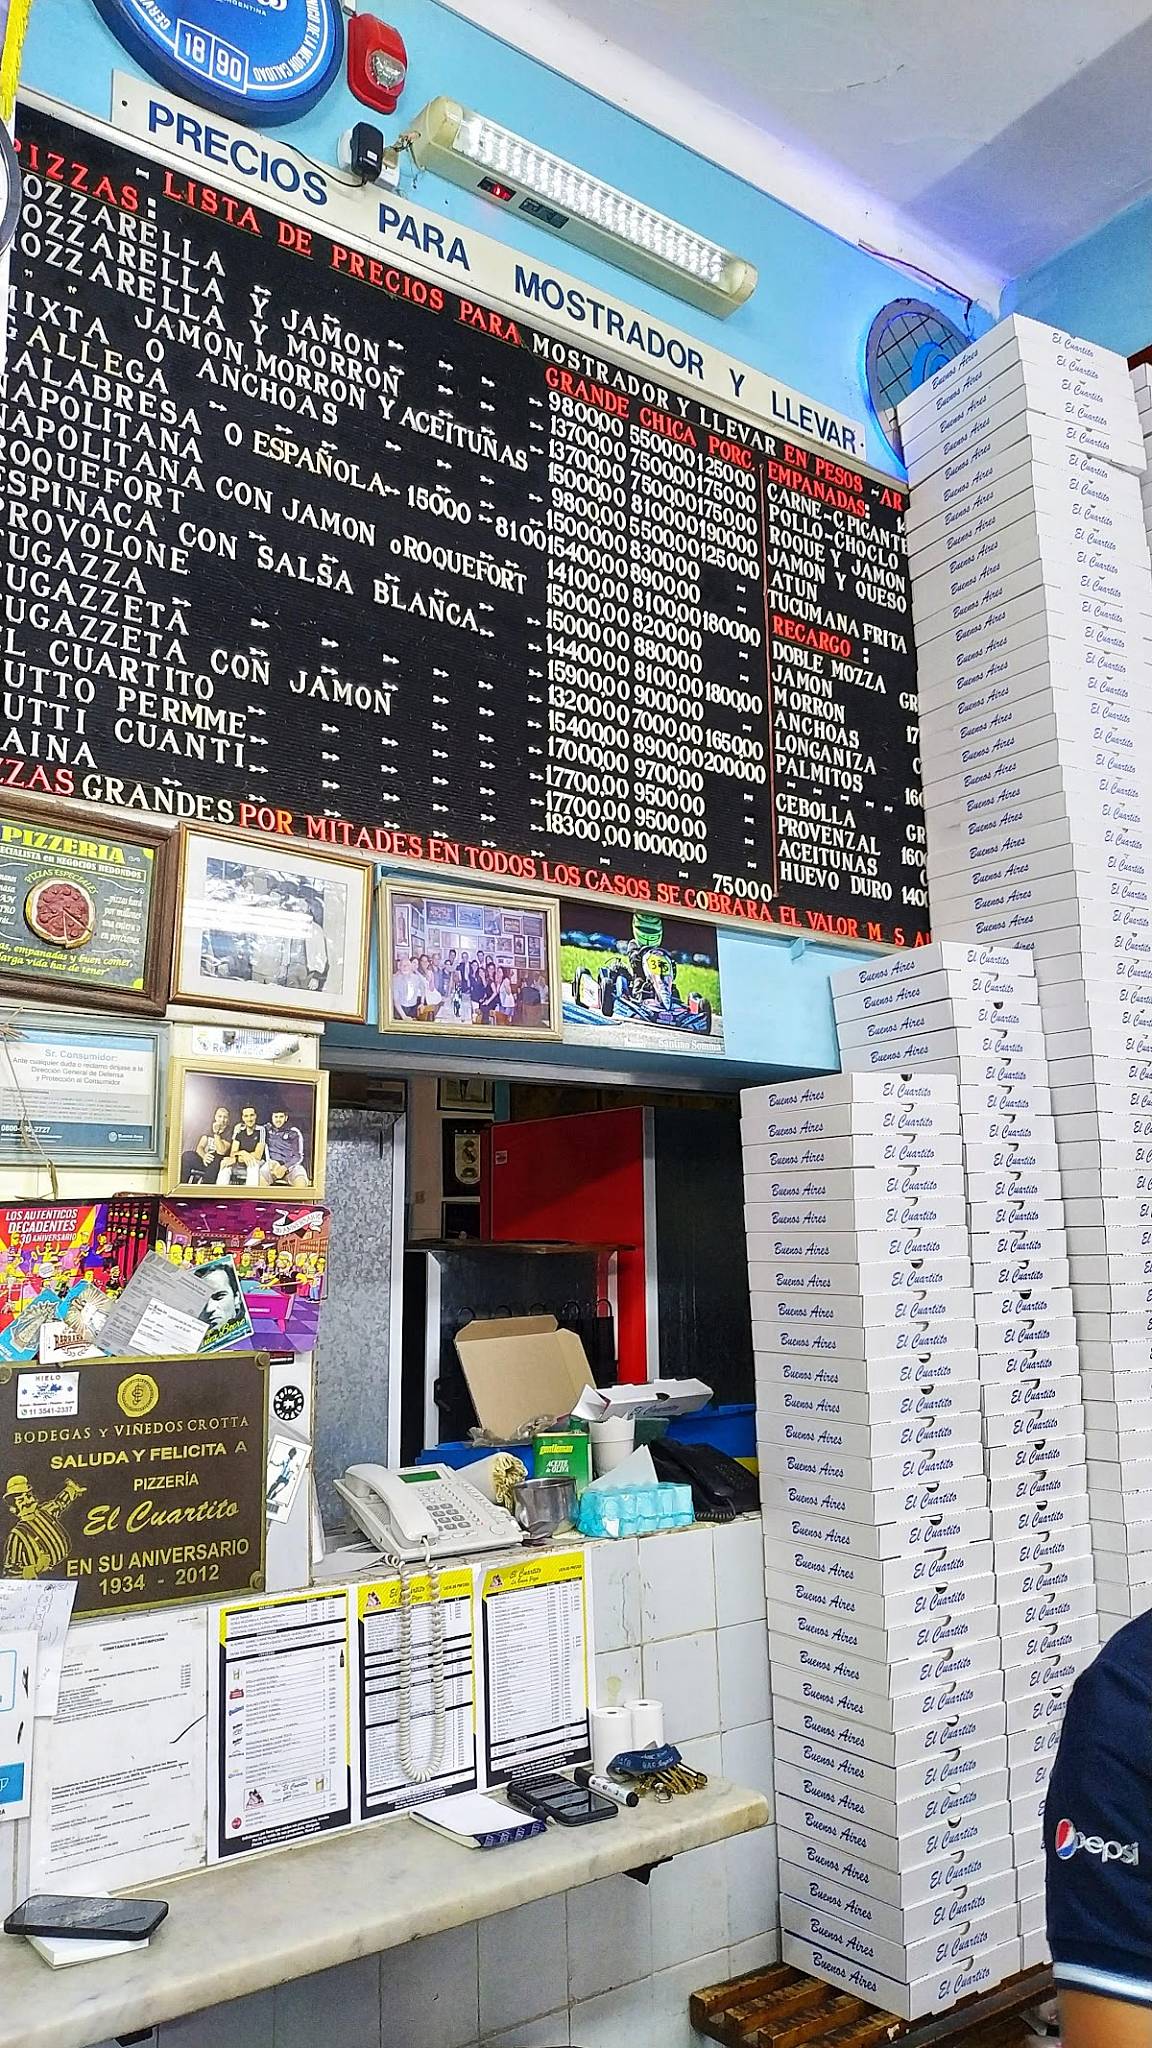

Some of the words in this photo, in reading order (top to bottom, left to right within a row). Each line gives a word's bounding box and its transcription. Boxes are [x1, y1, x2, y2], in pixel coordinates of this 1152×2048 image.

[184, 31, 206, 63] 18
[216, 47, 242, 83] 90
[252, 62, 294, 82] CALIDAD
[22, 173, 226, 277] OZZARELLA
[148, 101, 328, 207] PRECIOS
[378, 203, 470, 271] PARA
[515, 264, 704, 380] MOSTRADOR
[729, 368, 746, 397] Y
[22, 203, 225, 304] OZZARELLA
[249, 293, 269, 319] Y
[281, 309, 380, 365] JAMON
[163, 171, 262, 234] LISTA
[278, 221, 312, 256] DE
[331, 245, 445, 312] PRECIOS
[458, 300, 521, 347] PARA
[533, 333, 669, 411] MOSTRADOR
[677, 396, 690, 418] Y
[700, 407, 777, 456] LLEVAR
[783, 443, 808, 470] EN
[815, 457, 863, 492] PESOS
[1062, 336, 1095, 358] Cuartito
[249, 319, 268, 345] Y
[287, 334, 400, 397] MORRON
[931, 366, 957, 391] Buenos
[956, 348, 979, 370] Aires
[145, 338, 165, 363] O
[196, 358, 339, 426] ANCHOAS
[255, 350, 366, 411] MORRON
[379, 395, 396, 421] Y
[400, 406, 529, 472] ACEITUNAS
[3, 350, 201, 435] ALABRESA
[224, 422, 242, 446] O
[252, 430, 387, 496] ESPAÑOLA
[408, 485, 471, 525] 15000
[495, 517, 547, 550] 8100
[545, 367, 630, 419] GRANDE
[639, 407, 697, 448] CHICA
[708, 435, 756, 471] PORC.
[767, 460, 870, 520] EMPANADAS:
[215, 475, 273, 514] CON
[282, 498, 376, 546] JAMON
[0, 498, 190, 575] ROVOLONE
[0, 529, 146, 594] UGAZZA
[179, 522, 237, 560] CON
[258, 544, 354, 594] SALSA
[373, 578, 479, 631] BLANCA
[767, 549, 825, 584] JAMON
[835, 572, 847, 592] Y
[855, 581, 907, 614] QUESO
[768, 525, 825, 563] ROQUE
[832, 549, 842, 569] Y
[851, 559, 906, 594] JAMON
[0, 560, 189, 635] UGAZZETA
[770, 570, 818, 602] ATUN
[767, 590, 860, 639] TUCUMANA
[862, 622, 908, 655] FRITA
[772, 615, 853, 659] RECARGO
[0, 592, 187, 665] UGAZZETA
[210, 648, 270, 685] CON
[289, 669, 391, 715] JAMON
[49, 640, 214, 700] CUARTITO
[772, 640, 824, 675] DOBLE
[831, 659, 887, 694] MOZZA
[4, 660, 96, 704] UTTO
[117, 685, 247, 739] PERMME
[773, 686, 846, 725] MORRON
[0, 727, 98, 769] AINA
[3, 692, 87, 734] UTTI
[114, 717, 245, 768] CUANTI
[774, 709, 860, 750] ANCHOAS
[774, 730, 877, 776] LONGANIZA
[775, 753, 863, 793] PALMITOS
[776, 792, 857, 829] CEBOLLA
[1, 825, 126, 864] PIZZERIA
[777, 815, 882, 856] PROVENZAL
[82, 774, 234, 824] GRANDES
[240, 803, 293, 835] POR
[305, 815, 423, 859] MITADES
[428, 839, 460, 864] EN
[465, 846, 537, 880] TODOS
[541, 861, 581, 887] LOS
[585, 869, 649, 899] CASOS
[657, 883, 681, 905] SE
[684, 889, 773, 923] COBRARA
[780, 906, 802, 926] EL
[807, 912, 858, 938] VALOR
[868, 923, 882, 942] M
[894, 927, 905, 947] S
[778, 839, 878, 877] ACEITUNAS
[780, 860, 840, 891] HUEVO
[850, 875, 893, 901] DURO
[858, 968, 889, 984] Buenos
[890, 960, 916, 975] Aires
[967, 949, 978, 963] El
[979, 949, 1010, 966] Cuartito
[768, 1092, 798, 1107] Buenos
[800, 1089, 824, 1102] Aires
[882, 1082, 894, 1097] El
[897, 1082, 931, 1098] Cuartito
[6, 1210, 23, 1221] LOS
[24, 1209, 78, 1221] AUTENTICOS
[8, 1220, 76, 1234] DECADENTES
[775, 1273, 804, 1287] Buenos
[807, 1274, 831, 1288] Aires
[891, 1271, 903, 1287] El
[906, 1271, 943, 1287] Cuartito
[13, 1428, 91, 1444] BODEGAS
[99, 1429, 108, 1438] Y
[113, 1421, 184, 1437] VIÑEDOS
[188, 1416, 249, 1430] CROTTA
[50, 1450, 129, 1470] SALUDA
[132, 1450, 145, 1462] Y
[150, 1443, 227, 1462] FELICITA
[235, 1441, 248, 1453] A
[133, 1470, 199, 1491] PIZZERÍA
[83, 1505, 119, 1536] El
[126, 1499, 240, 1533] Cuartito
[67, 1558, 92, 1578] EN
[98, 1553, 125, 1573] SU
[128, 1539, 249, 1570] ANIVERSARIO
[99, 1576, 145, 1596] 1934
[175, 1564, 220, 1586] 2012
[1076, 1828, 1139, 1866] pepsi
[812, 1951, 846, 1980] Buenos
[848, 1971, 877, 1993] Aires
[938, 1979, 951, 2001] El
[953, 1967, 990, 1996] Cuartito
